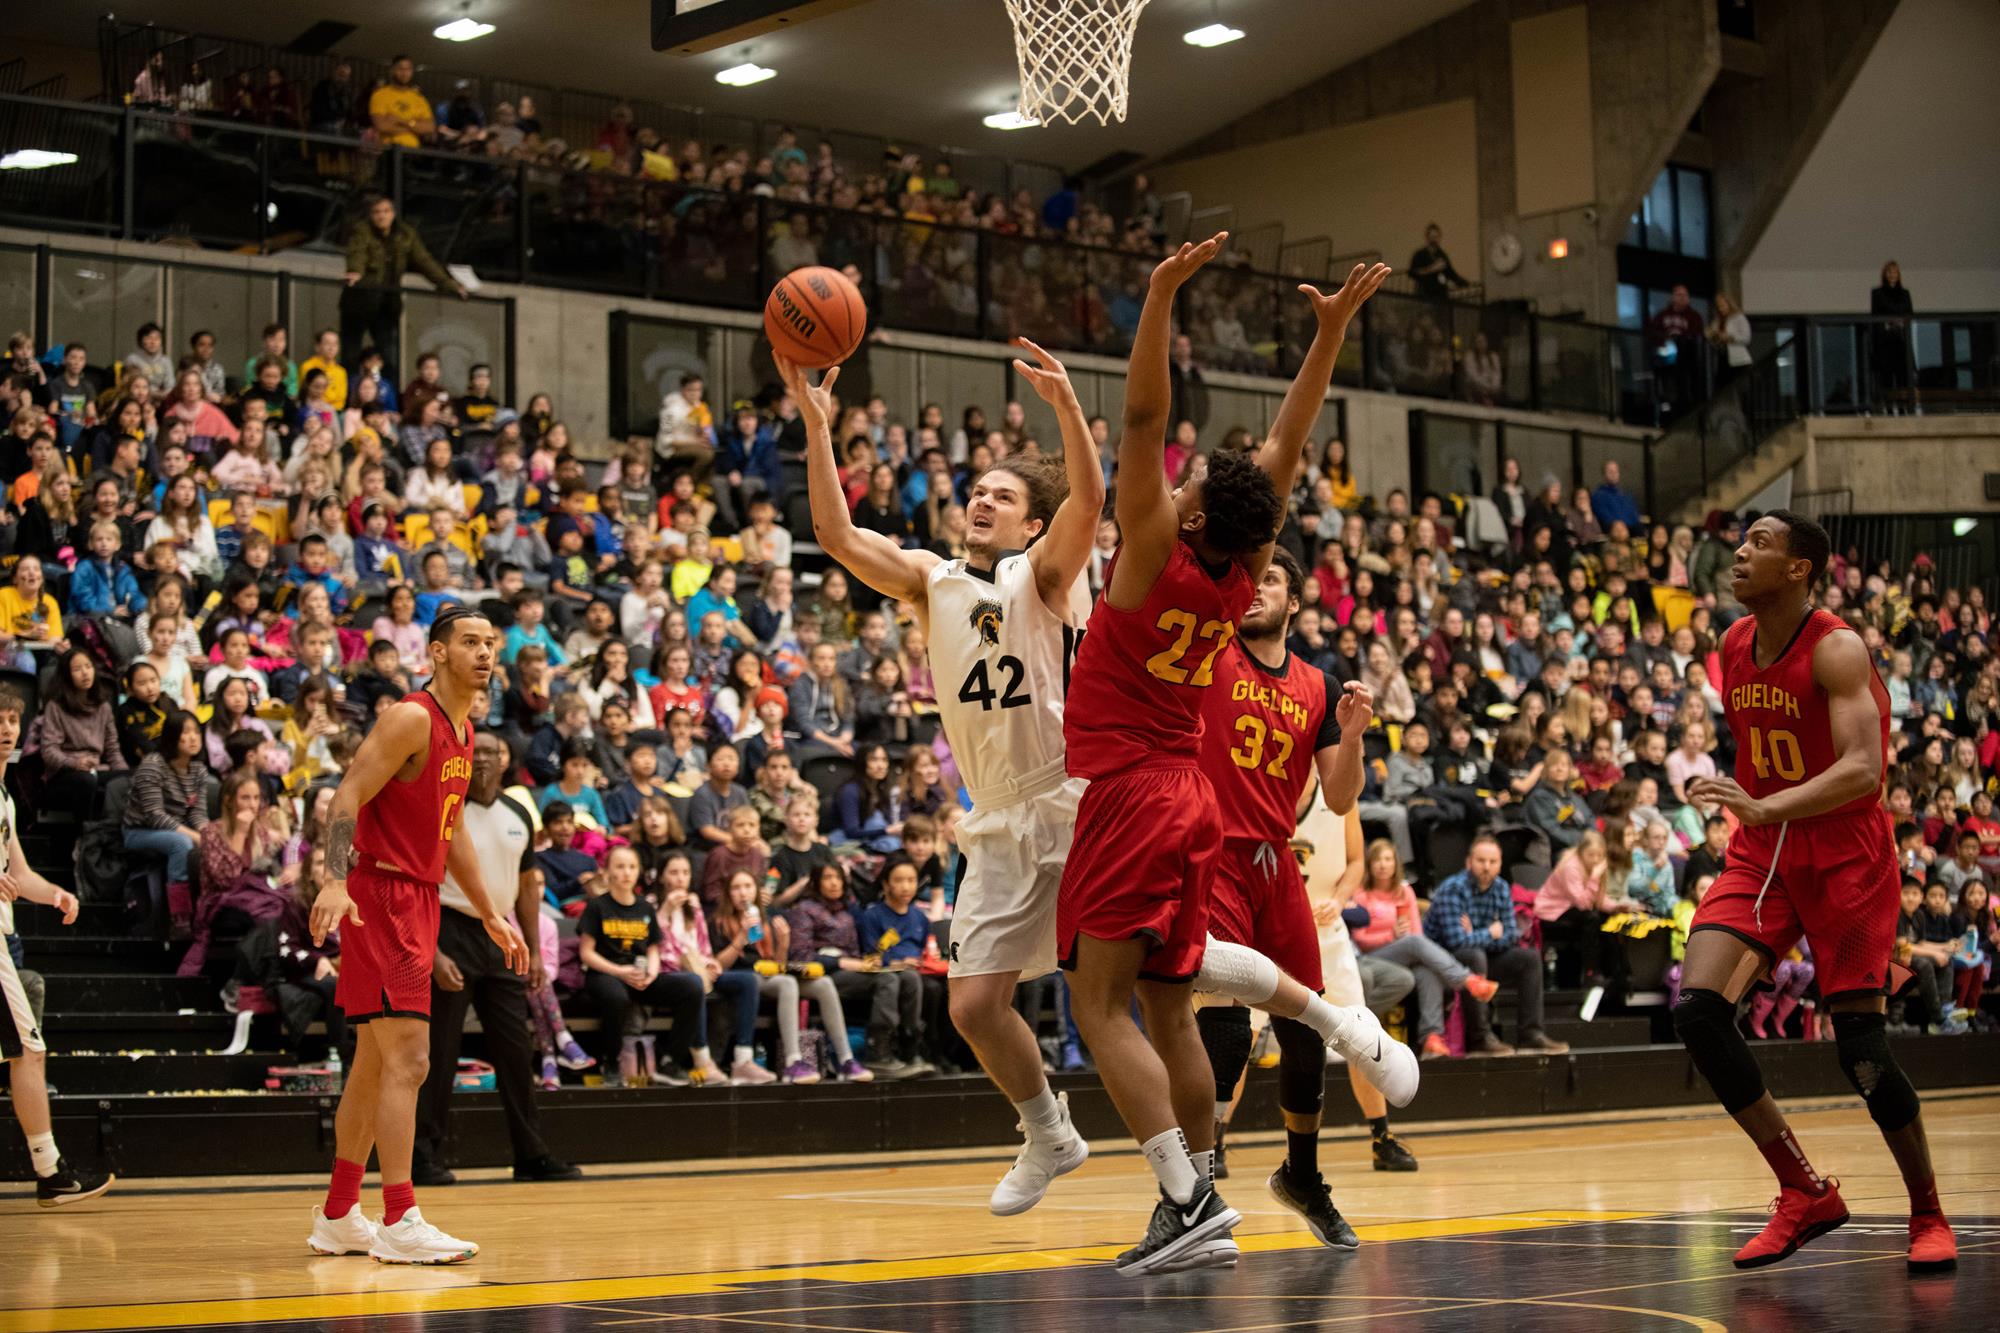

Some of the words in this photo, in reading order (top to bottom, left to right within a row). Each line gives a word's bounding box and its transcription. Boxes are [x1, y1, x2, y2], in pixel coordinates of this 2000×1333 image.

[775, 284, 816, 338] Wilson
[1146, 608, 1235, 688] 22
[958, 655, 1032, 711] 42
[1231, 679, 1309, 732] GUELPH
[1731, 683, 1801, 719] GUELPH
[440, 756, 473, 783] GUELP
[1230, 714, 1295, 781] 32
[1750, 725, 1806, 782] 40
